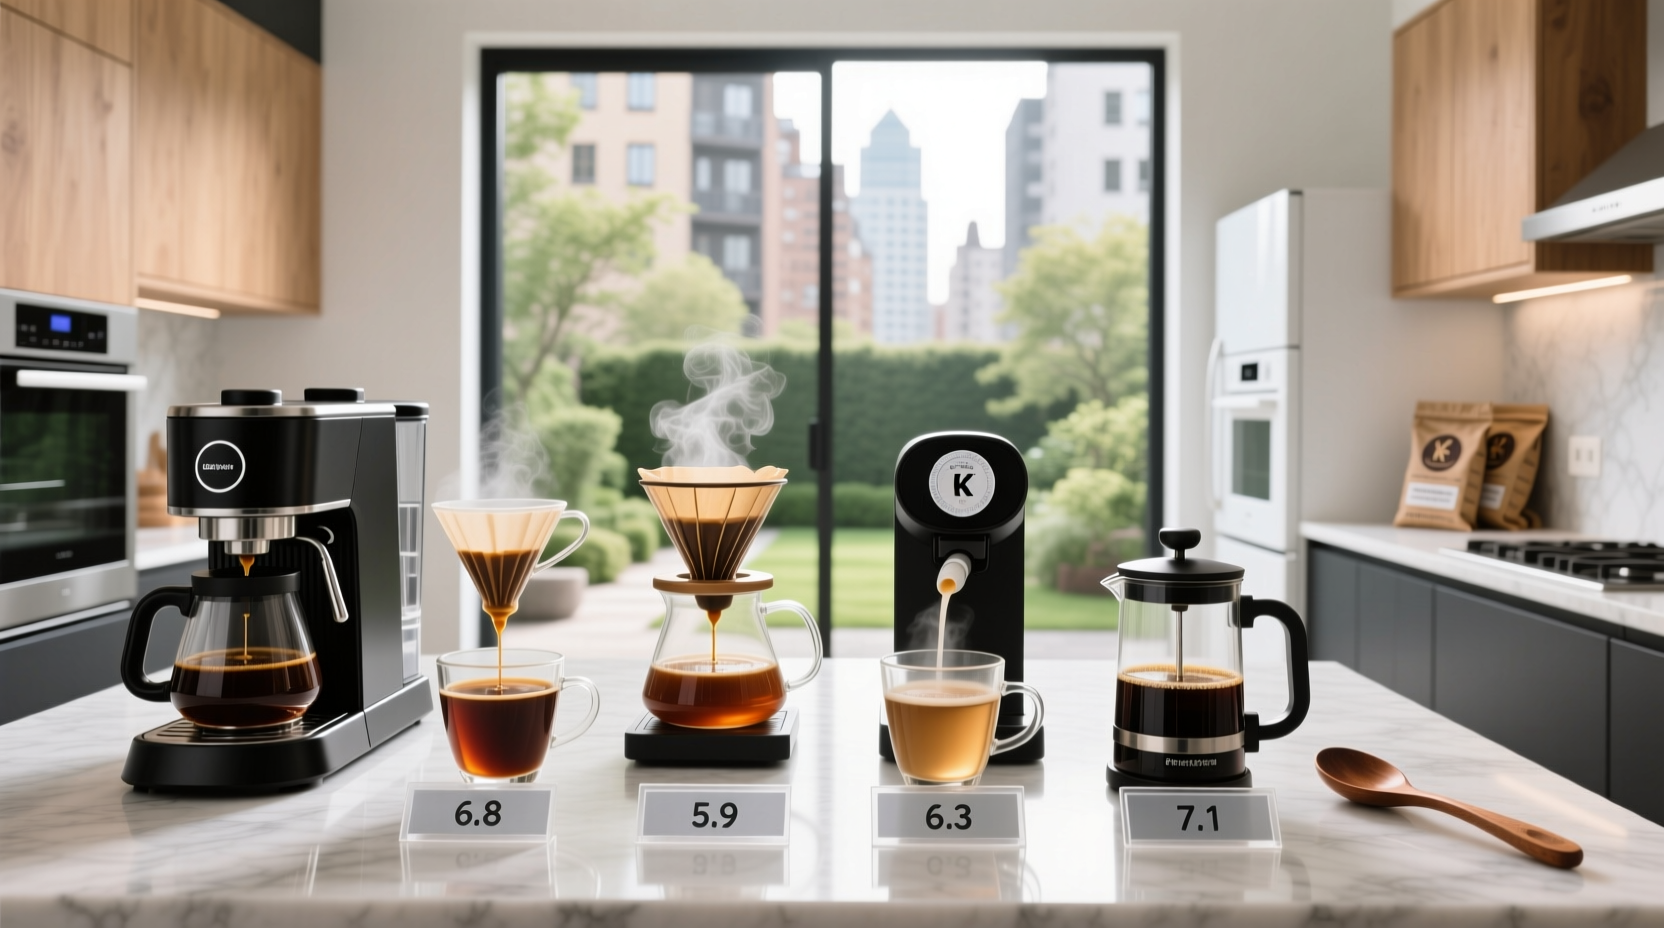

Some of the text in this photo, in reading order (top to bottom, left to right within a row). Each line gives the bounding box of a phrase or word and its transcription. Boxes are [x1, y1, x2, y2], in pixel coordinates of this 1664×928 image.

[953, 473, 974, 497] K
[455, 800, 501, 826] 6.8
[692, 802, 737, 828] 5.9
[926, 804, 972, 830] 6.3
[1177, 805, 1219, 831] 7.1
